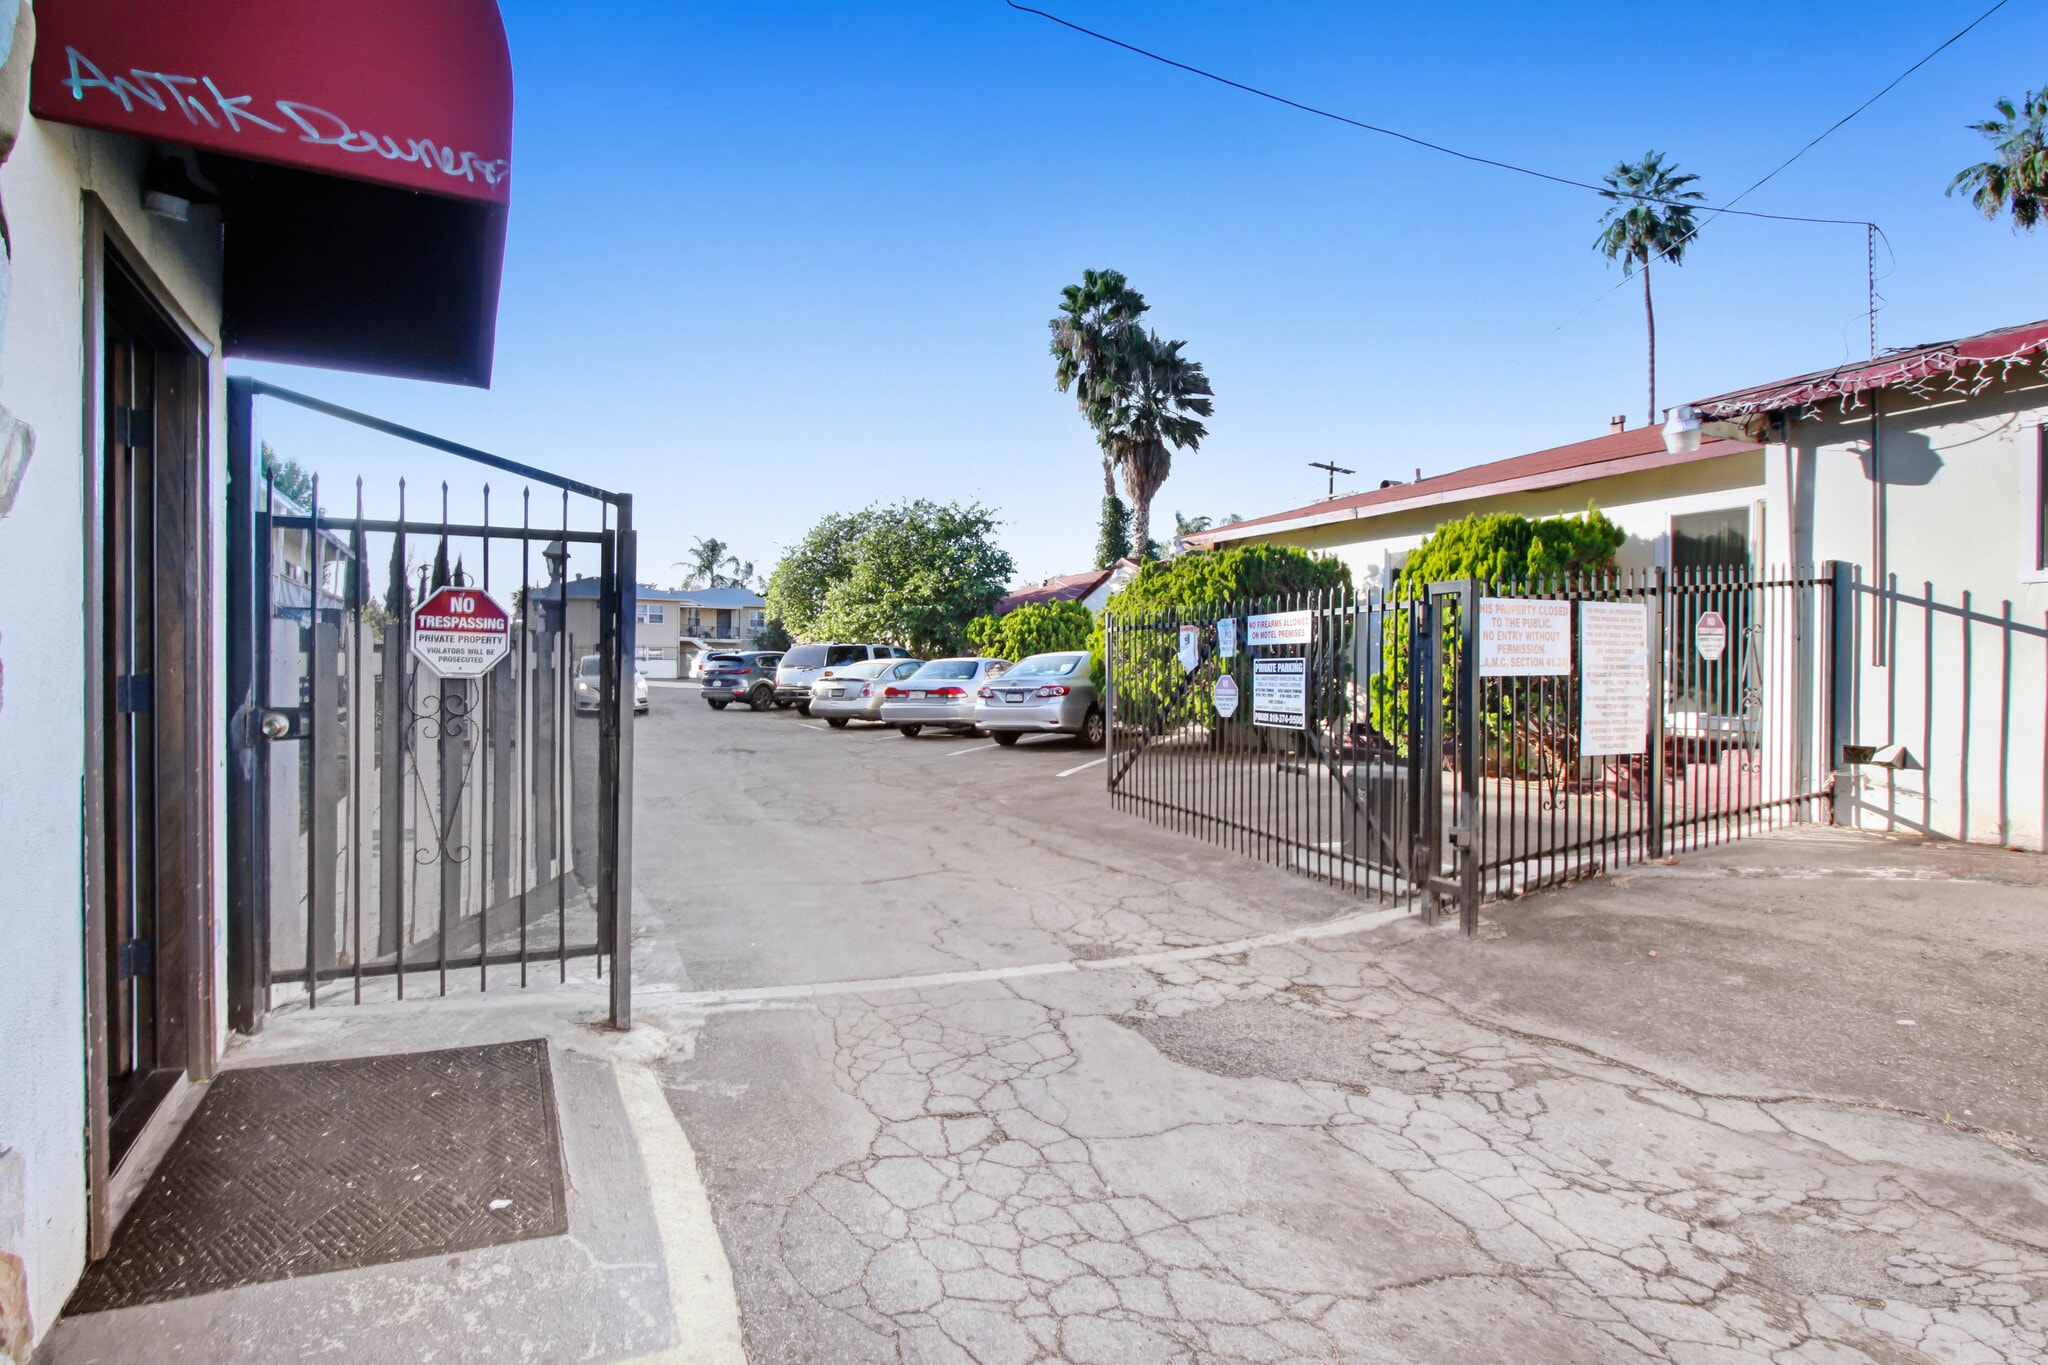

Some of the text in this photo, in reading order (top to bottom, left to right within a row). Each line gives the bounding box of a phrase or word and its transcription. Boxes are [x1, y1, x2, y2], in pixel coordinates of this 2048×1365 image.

[450, 596, 475, 614] NO
[1480, 604, 1569, 616] HIS PROPERTY CLOSED
[418, 615, 505, 630] TRESPASSING
[1257, 620, 1282, 628] FIREARMS
[1283, 618, 1309, 626] ALLOWED
[1491, 617, 1552, 628] TO THE PUBLIC.
[419, 634, 503, 644] PRIVATE PROPERTY
[1260, 630, 1276, 639] MOTEL
[1278, 629, 1305, 638] PREMISES
[1483, 630, 1560, 641] NO ENTRY WITHOUT
[426, 647, 465, 655] VIOLATORS
[1497, 644, 1547, 655] PERMISSION.
[1510, 657, 1544, 667] SECTION
[1255, 663, 1302, 672] PRIVATE PARKING
